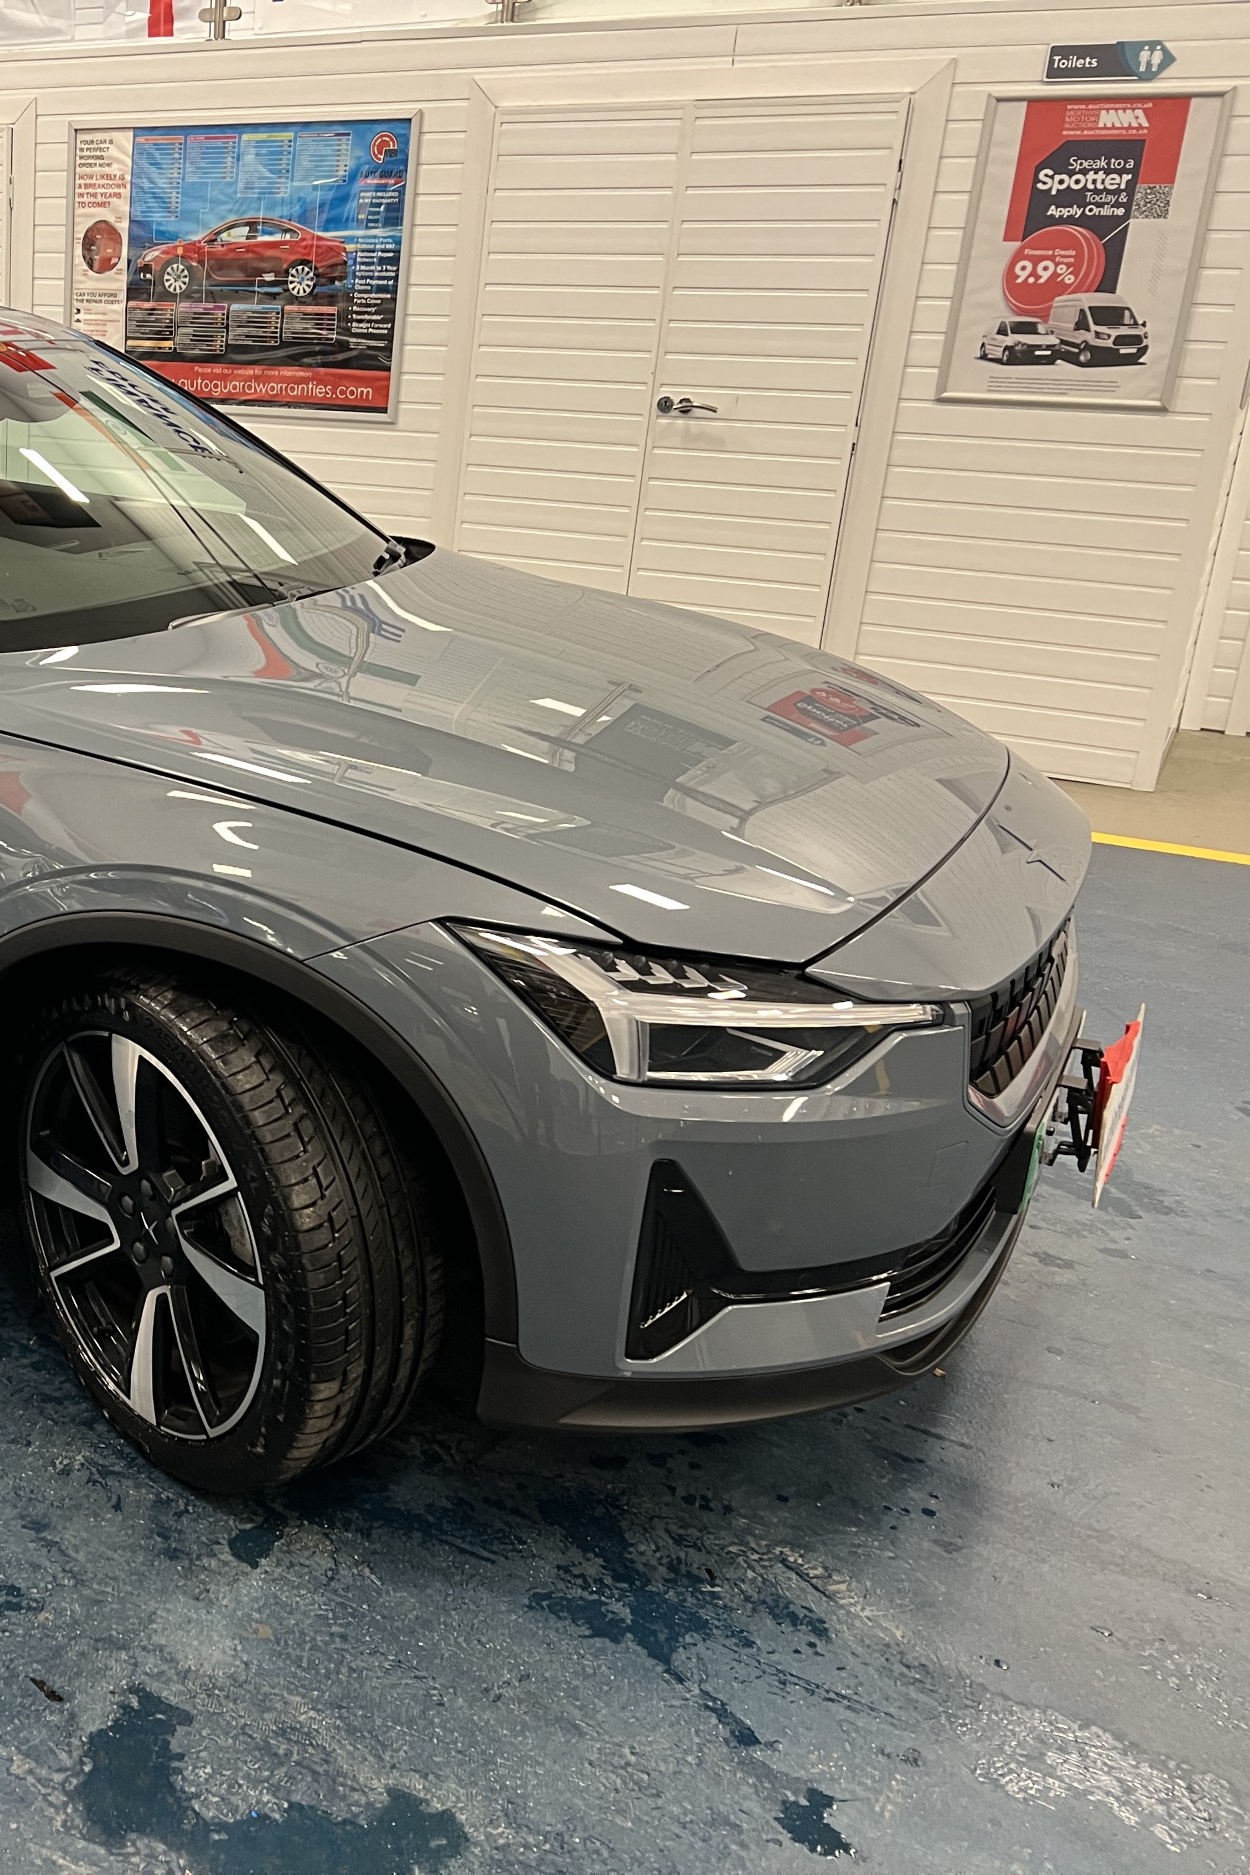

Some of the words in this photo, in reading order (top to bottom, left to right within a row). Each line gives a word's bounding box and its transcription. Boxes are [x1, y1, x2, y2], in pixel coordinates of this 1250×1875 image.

[1052, 56, 1098, 68] Toilets
[1098, 109, 1150, 128] MMA
[1069, 156, 1108, 172] Speak
[1110, 158, 1124, 169] to
[1126, 159, 1134, 168] a
[78, 173, 94, 181] HOW
[95, 173, 117, 181] LIKELY
[118, 173, 126, 181] IS
[1036, 168, 1132, 195] Spotter
[83, 182, 127, 190] BREAKDOWN
[1085, 192, 1118, 205] Today
[1119, 192, 1128, 202] &
[1046, 205, 1083, 218] Apply
[1085, 205, 1125, 216] Online
[1054, 248, 1076, 256] Deals
[1014, 260, 1075, 284] 9.9%
[194, 366, 211, 374] Please
[212, 366, 222, 374] visit
[233, 367, 254, 375] website
[255, 368, 263, 376] for
[280, 369, 312, 378] information
[174, 377, 373, 400] autoguardwarranties.com
